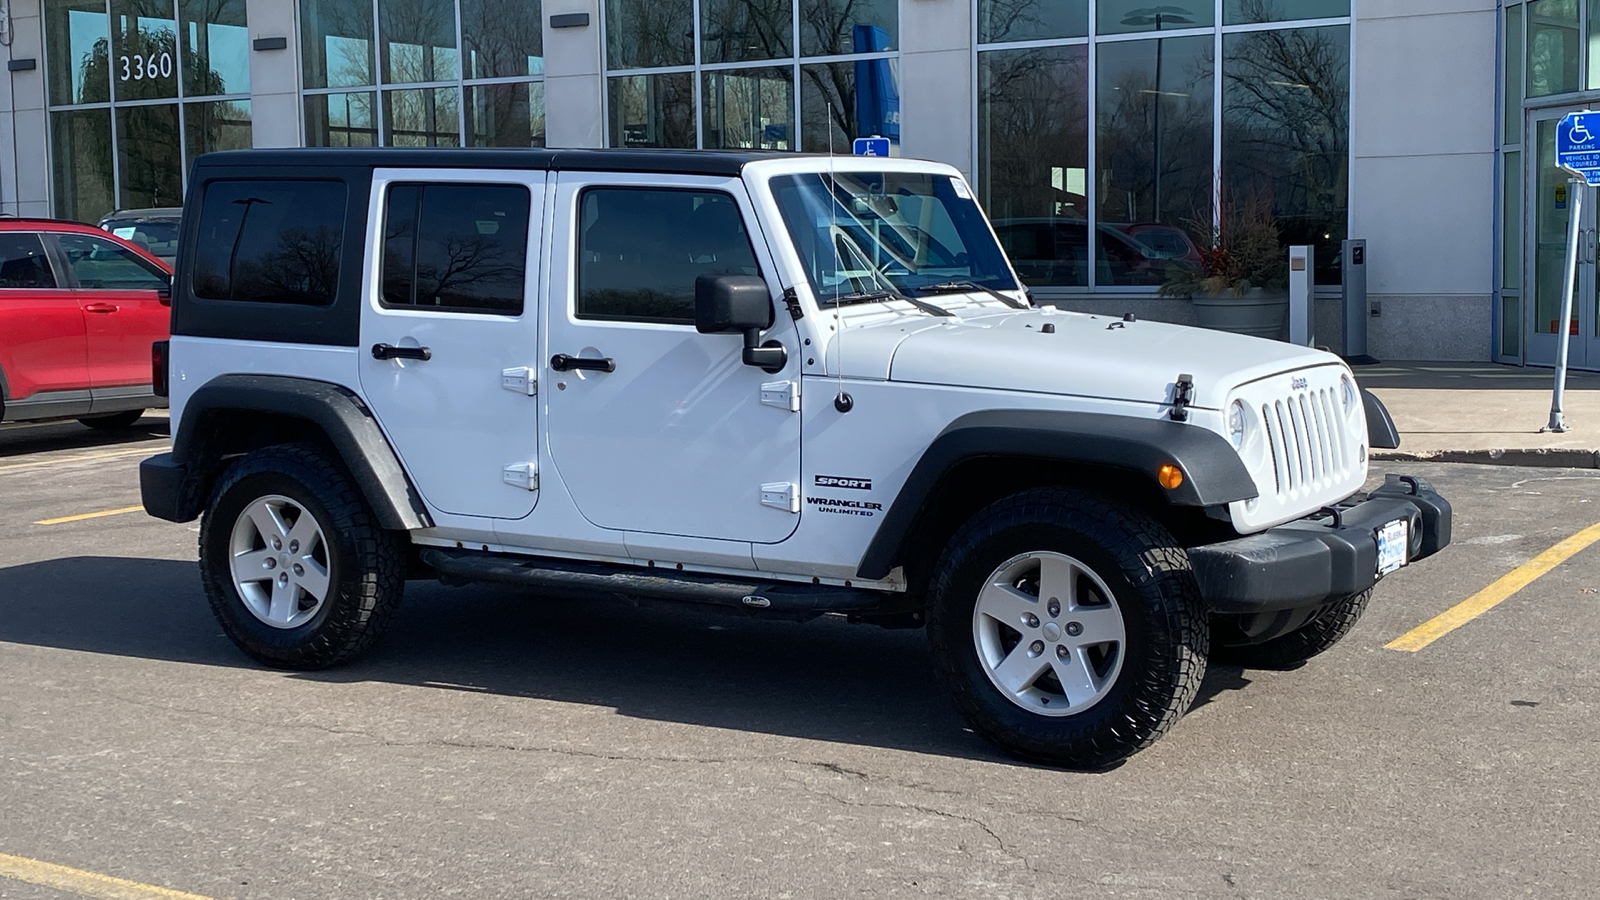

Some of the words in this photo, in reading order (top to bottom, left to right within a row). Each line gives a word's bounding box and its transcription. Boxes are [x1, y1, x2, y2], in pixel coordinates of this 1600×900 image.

[120, 52, 172, 81] 3360
[1291, 376, 1308, 391] Jeep
[817, 477, 870, 488] SPORT
[806, 497, 882, 511] WRANGLER
[818, 507, 873, 517] UNLIMITED
